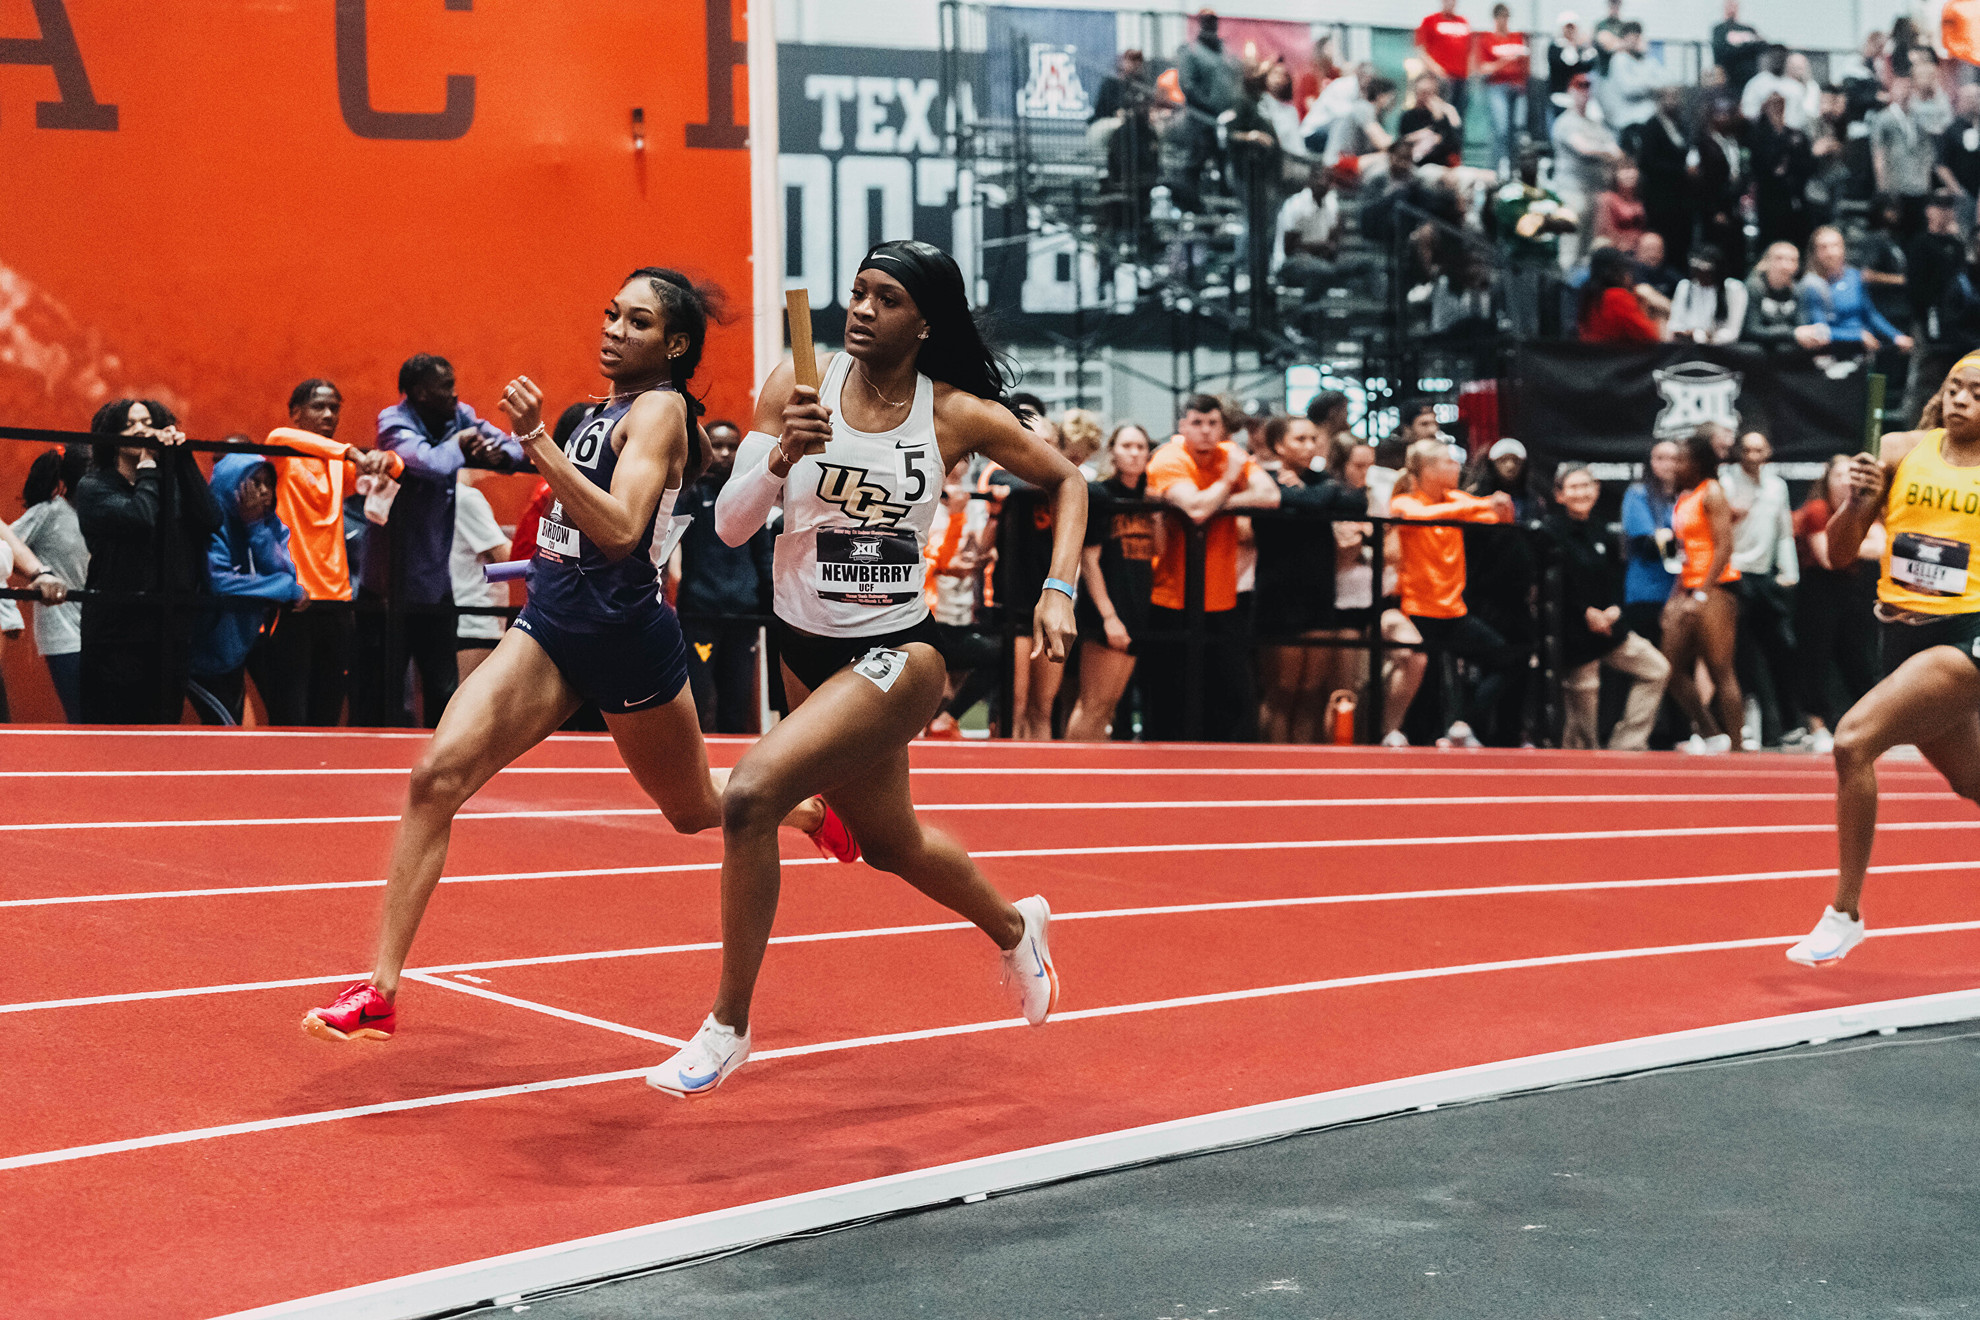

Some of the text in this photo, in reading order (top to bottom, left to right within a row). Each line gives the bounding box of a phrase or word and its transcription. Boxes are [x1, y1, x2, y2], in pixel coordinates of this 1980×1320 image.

[575, 421, 605, 463] 6
[903, 450, 926, 502] 5
[815, 461, 913, 528] UCF
[1905, 483, 1980, 517] BAYLO
[851, 541, 881, 558] XII
[822, 564, 913, 583] NEWBERRY
[858, 583, 875, 592] UCF
[862, 651, 898, 680] 5
